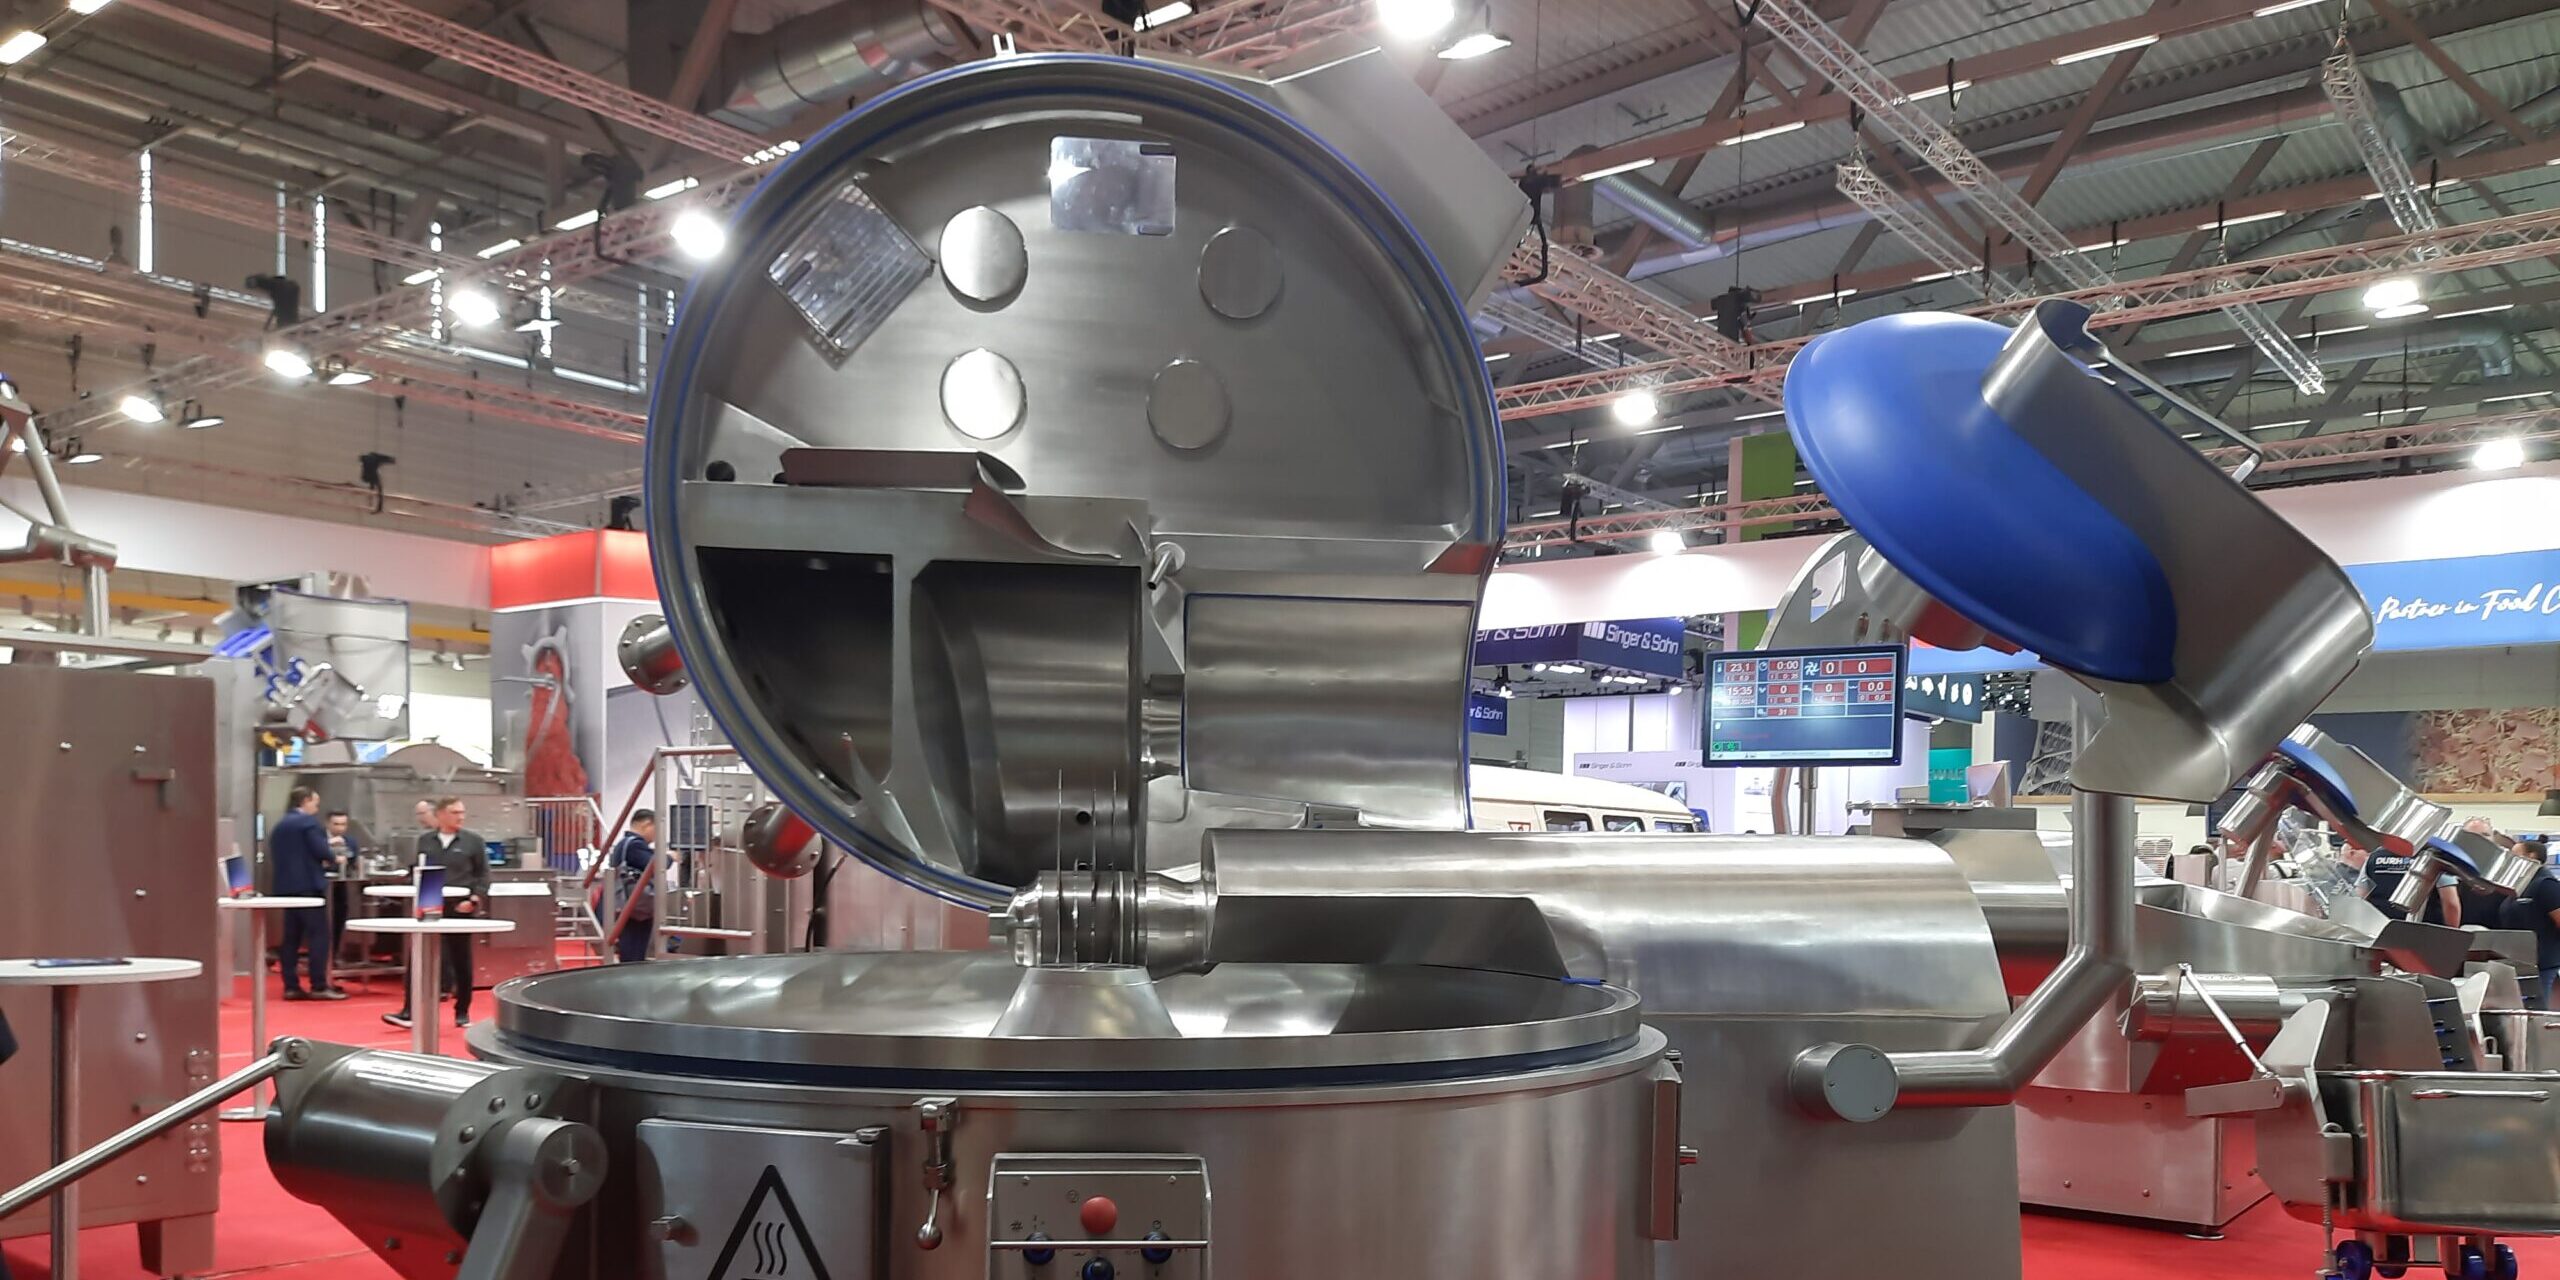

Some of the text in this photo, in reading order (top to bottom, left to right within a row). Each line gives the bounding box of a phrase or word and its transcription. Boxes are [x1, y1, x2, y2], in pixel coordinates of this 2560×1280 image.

[2376, 595, 2451, 625] Partner
[2480, 583, 2543, 621] Food
[1606, 624, 1679, 655] Singer & Sohn
[1777, 661, 1799, 670] 0:00
[1825, 661, 1867, 674] 0 0
[1780, 685, 1788, 694] 0
[1825, 683, 1833, 693] 0
